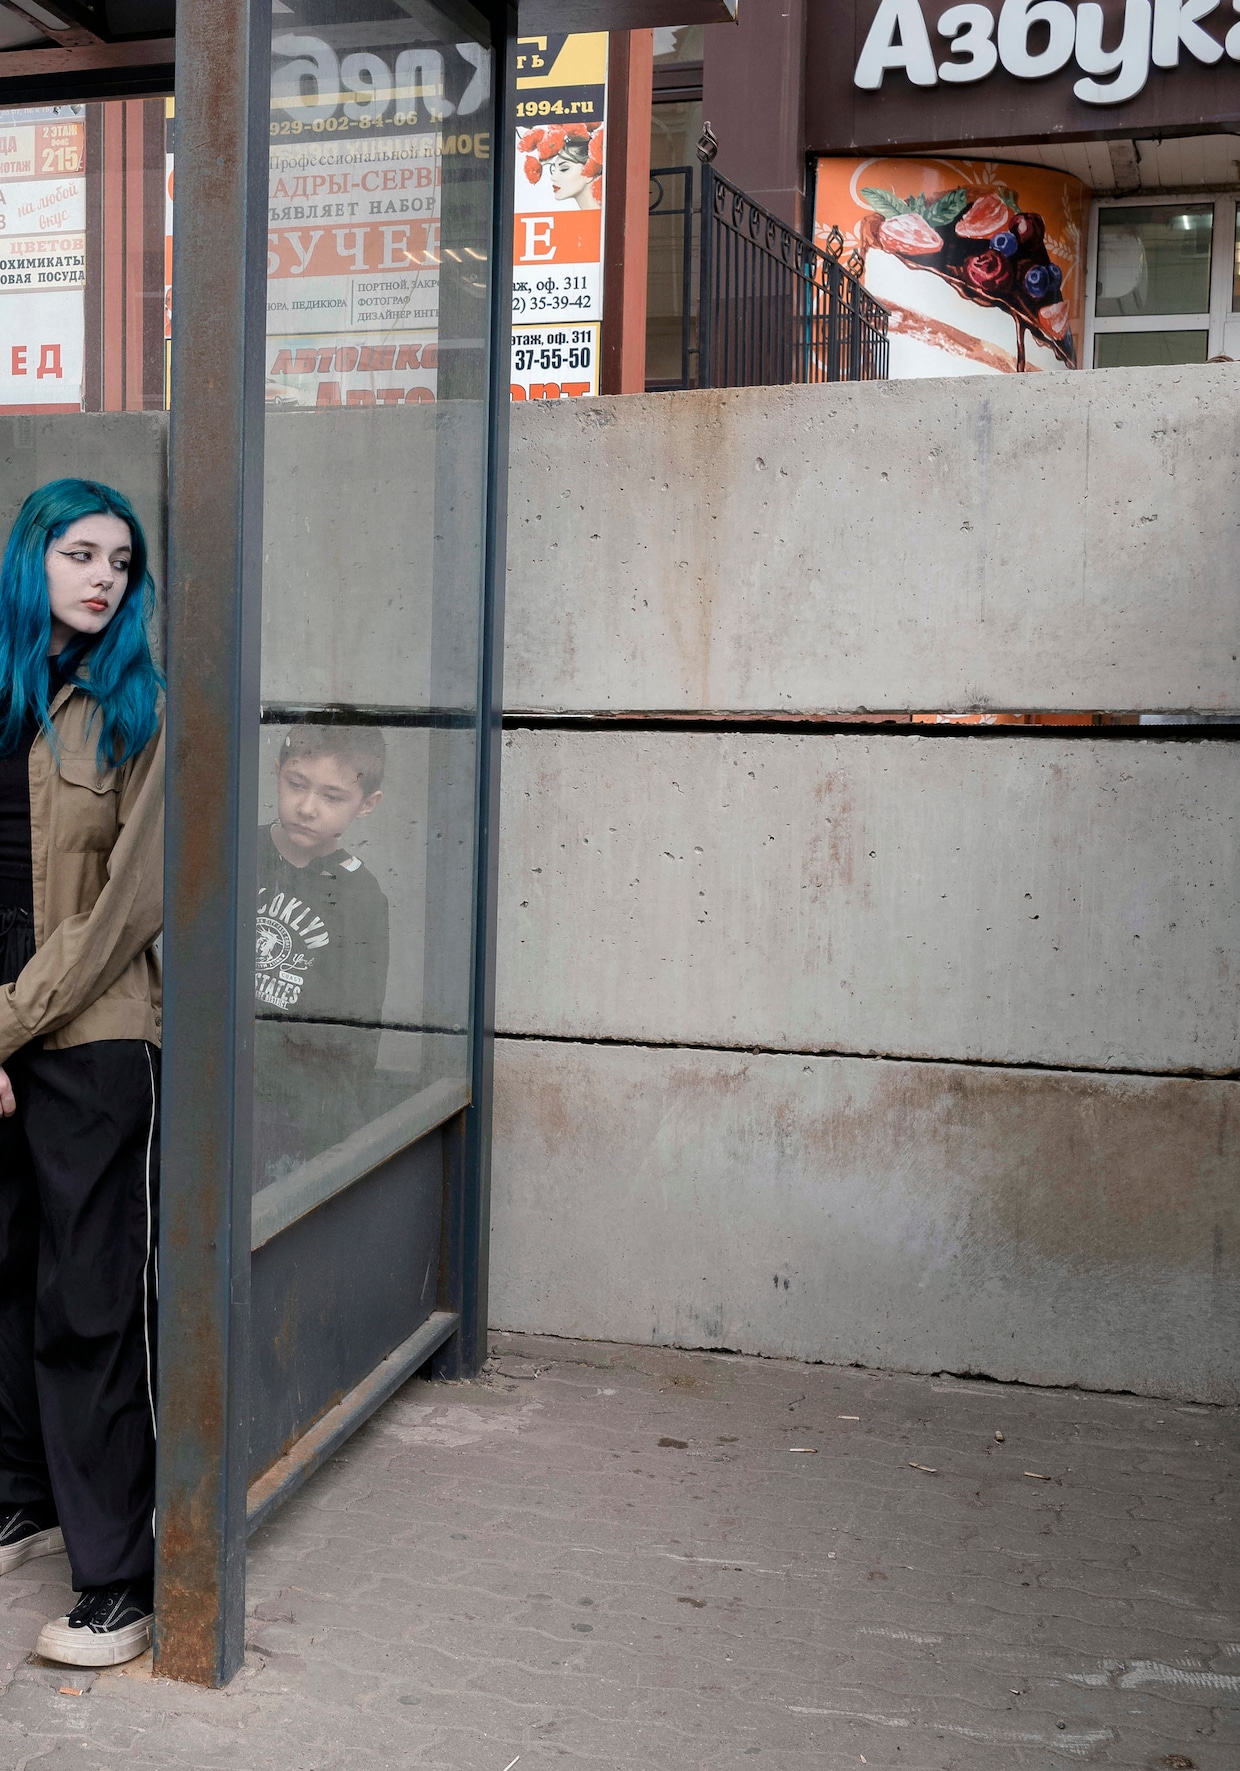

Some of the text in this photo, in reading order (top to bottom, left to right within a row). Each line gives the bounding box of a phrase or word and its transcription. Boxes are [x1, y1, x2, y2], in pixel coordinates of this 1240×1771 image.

[516, 100, 594, 117] 1994.ru
[43, 125, 77, 138] 2 ЭТАЖ
[42, 147, 78, 171] 215
[269, 147, 419, 172] Профессиональной
[268, 166, 442, 202] АДРЫ-СЕРВ
[18, 182, 78, 217] на любой
[369, 197, 437, 215] НАБОР
[39, 209, 68, 230] вкус
[10, 238, 84, 256] ЦВЕТОВ
[38, 270, 84, 284] ПОСУДА
[358, 279, 409, 292] ПОРТНОЙ,
[536, 278, 559, 294] оф.
[564, 276, 587, 290] 311
[292, 299, 347, 310] ПЕДИКЮРА
[358, 296, 411, 307] ФОТОГРАФ
[530, 295, 591, 310] 35-39-42
[357, 309, 411, 322] ДИЗАЙНЕР
[547, 332, 569, 346] оф.
[572, 330, 591, 343] 311
[515, 347, 591, 371] 37-55-50
